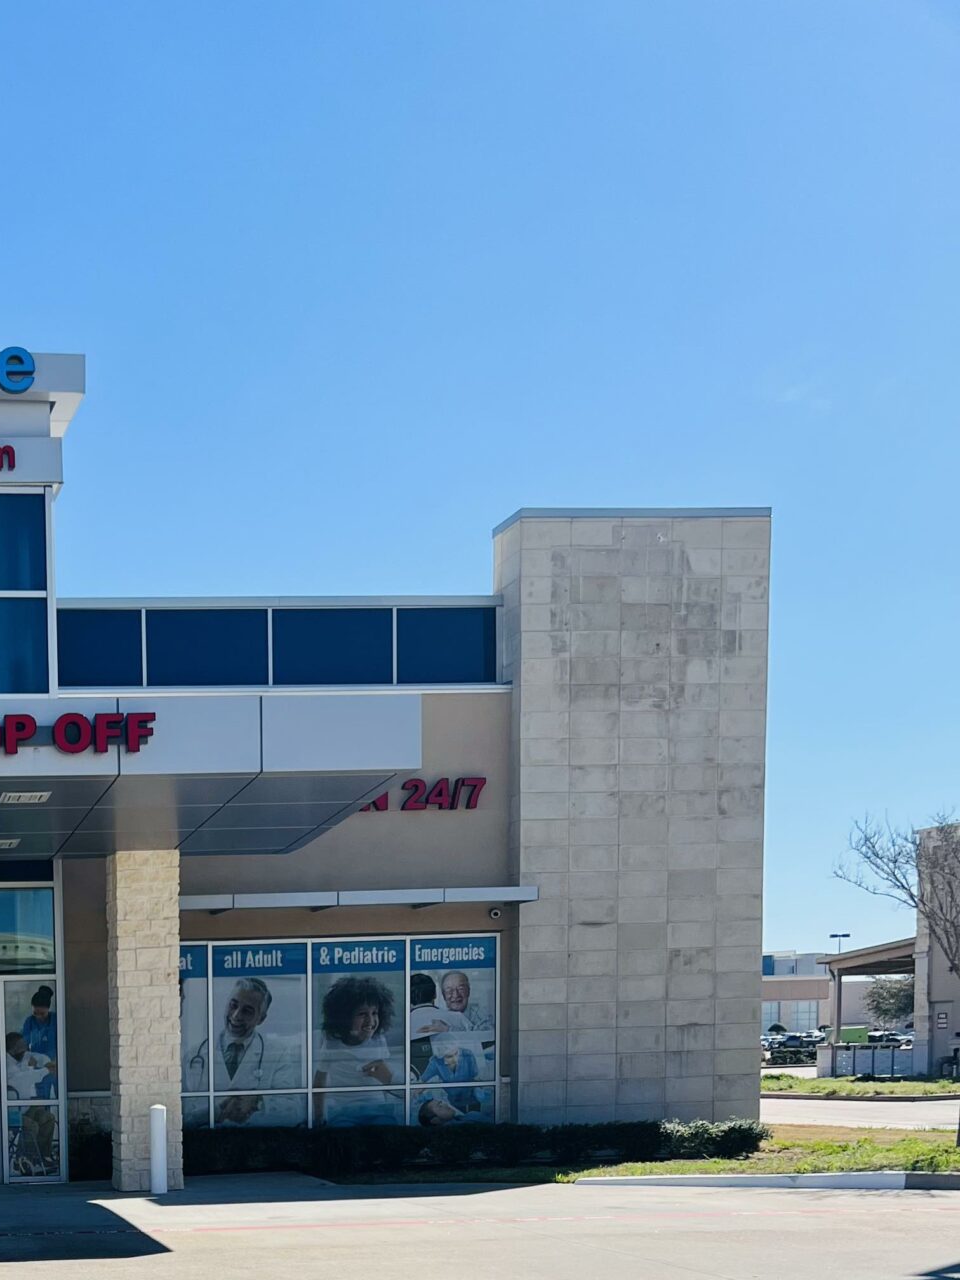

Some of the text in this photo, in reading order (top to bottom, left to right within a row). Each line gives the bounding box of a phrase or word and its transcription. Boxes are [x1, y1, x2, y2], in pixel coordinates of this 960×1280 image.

[52, 712, 157, 753] OFF
[400, 777, 487, 811] 24/7
[224, 951, 241, 969] all
[245, 949, 283, 968] Adult
[319, 946, 330, 965] &
[334, 946, 397, 965] Pediatric
[415, 944, 485, 964] Emergencies
